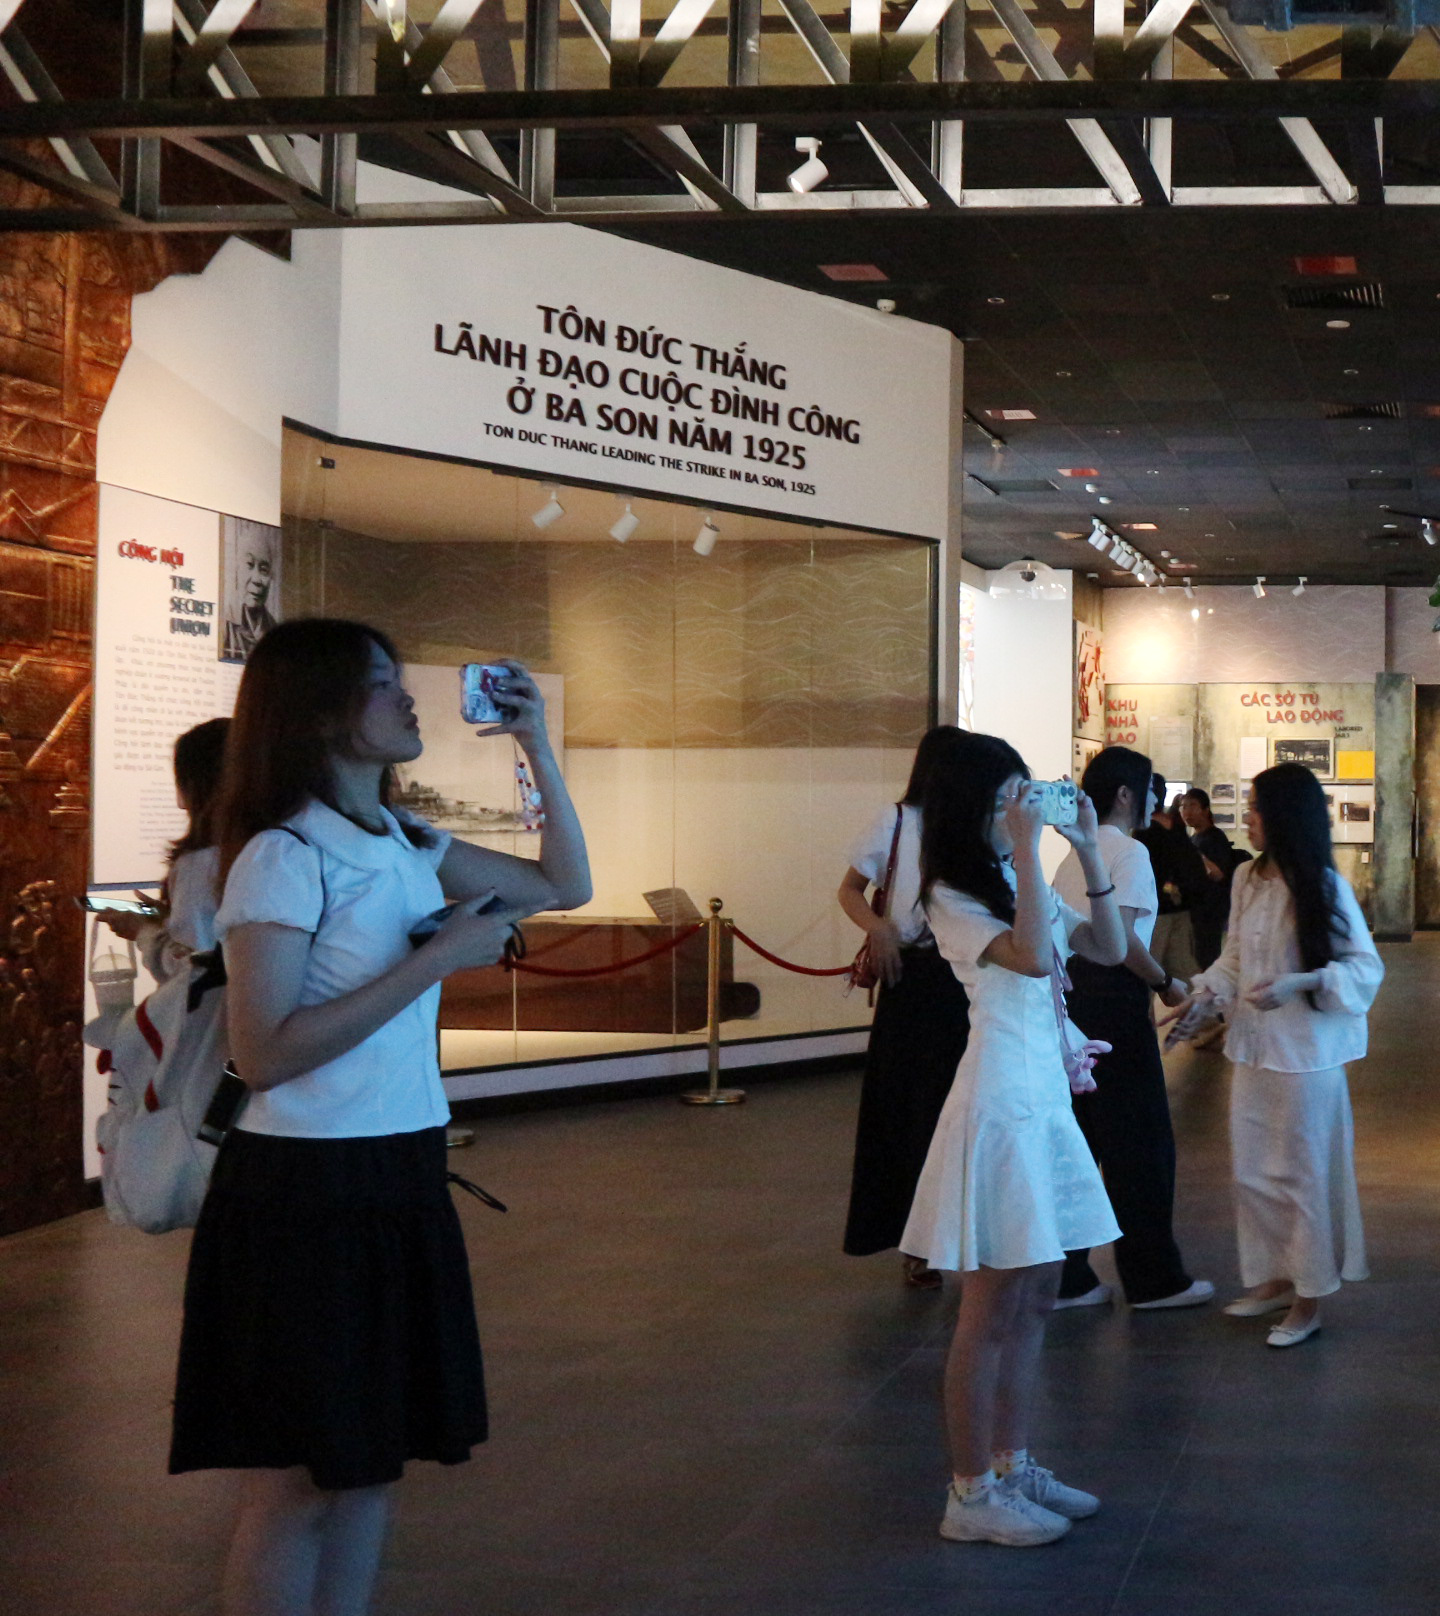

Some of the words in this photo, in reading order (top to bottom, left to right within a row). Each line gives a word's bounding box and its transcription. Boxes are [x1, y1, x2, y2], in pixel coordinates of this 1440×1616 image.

[536, 304, 606, 347] TÔN
[615, 323, 683, 365] ĐỨC
[690, 341, 787, 391] THẮNG
[434, 322, 527, 371] LÃNH
[537, 348, 610, 390] ĐẠO
[619, 367, 703, 412] CUỘC
[709, 386, 780, 427] ĐÌNH
[787, 404, 861, 445] CÔNG
[506, 376, 536, 415] Ở
[545, 392, 588, 427] BA
[596, 403, 658, 441] SON
[668, 416, 732, 456] NĂM
[743, 434, 806, 470] 1925
[483, 422, 514, 439] TON
[518, 429, 548, 446] DUC
[551, 435, 598, 455] THANG
[601, 445, 656, 467] LEADING
[659, 455, 683, 472] THE
[686, 460, 726, 479] STRIKE
[729, 469, 742, 481] IN
[744, 472, 759, 485] BA
[762, 475, 788, 493] SON,
[790, 481, 816, 496] 1925
[118, 538, 157, 563] CÔNG
[169, 574, 196, 594] THE
[169, 596, 216, 617] SECRET
[169, 617, 211, 637] UNION
[1107, 699, 1138, 712] KHU
[1240, 691, 1271, 707] CÁC
[1106, 713, 1139, 728] NHÀ
[1266, 710, 1297, 723] LAO
[1299, 707, 1345, 725] ĐỘNG
[1106, 731, 1137, 745] LAO
